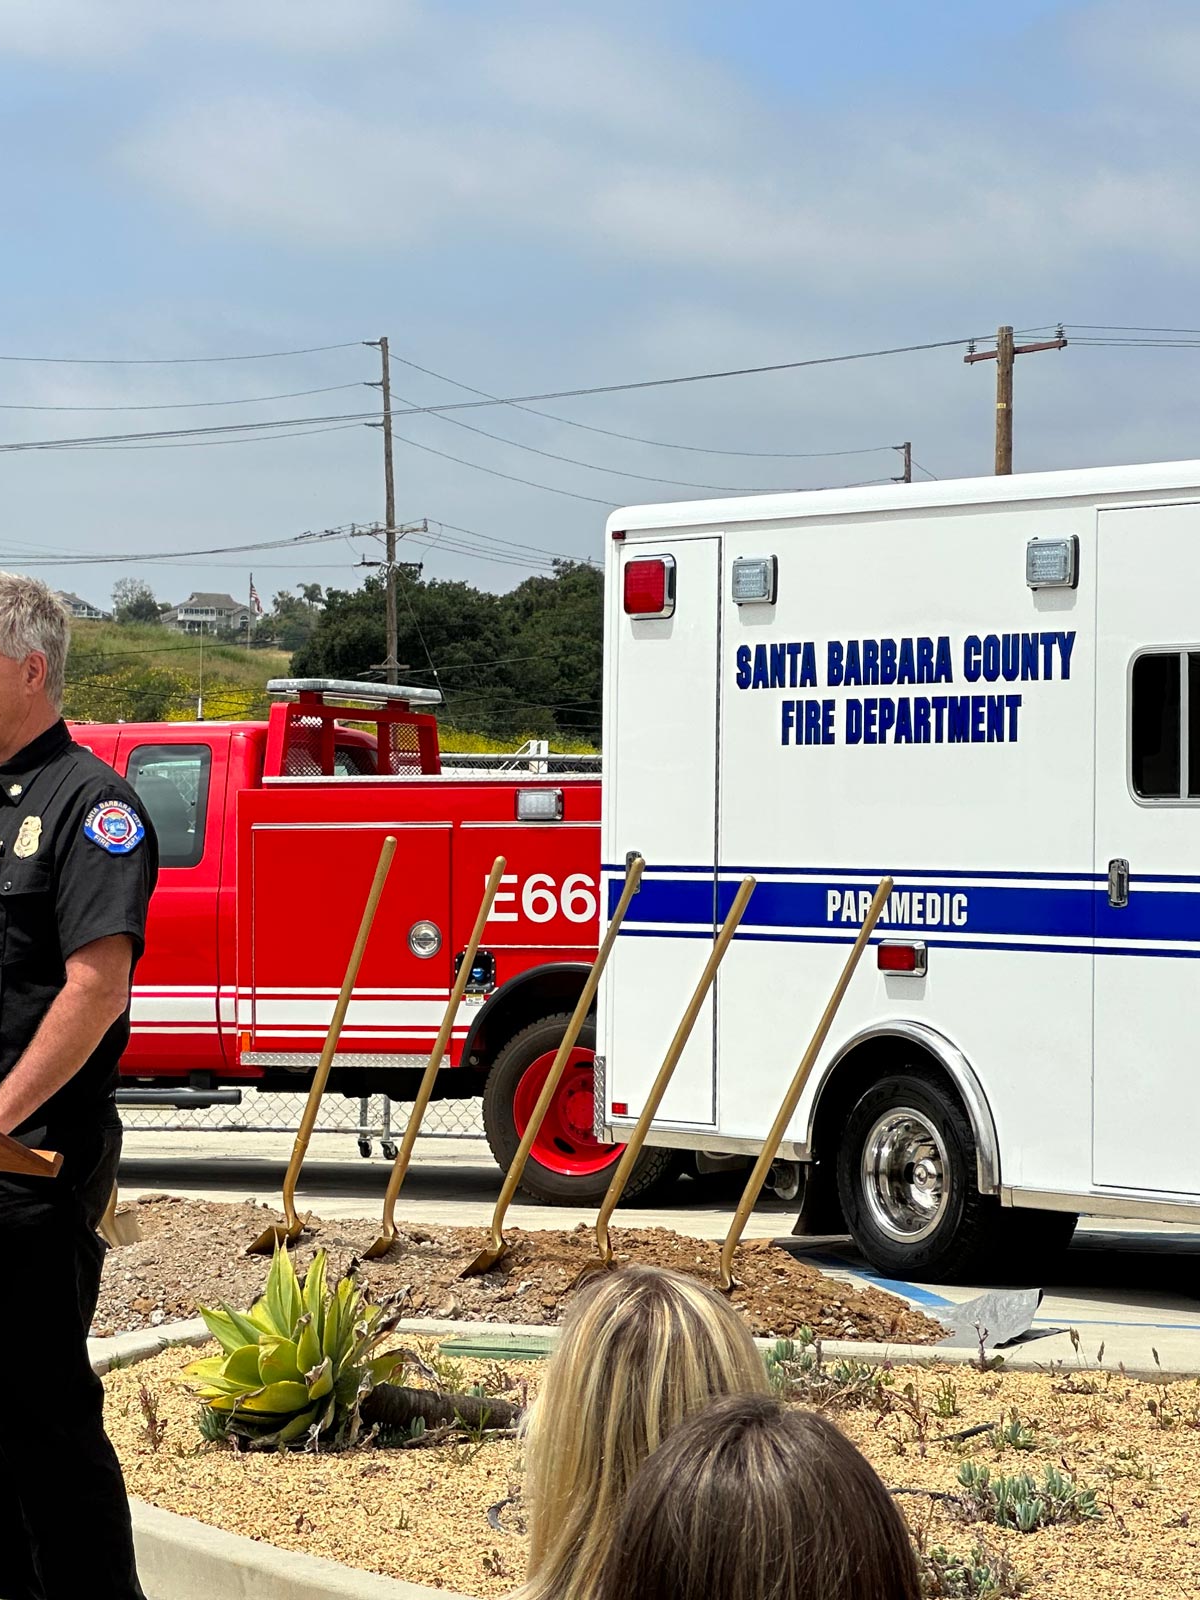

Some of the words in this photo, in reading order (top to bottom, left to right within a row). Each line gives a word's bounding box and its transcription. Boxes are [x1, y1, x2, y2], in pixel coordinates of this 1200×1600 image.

[736, 642, 817, 690] SANTA
[827, 636, 953, 687] BARBARA
[963, 631, 1076, 682] COUNTY
[781, 699, 836, 746] FIRE
[845, 694, 1022, 745] DEPARTMENT
[85, 807, 99, 827] SANTA
[94, 835, 111, 848] FIRE
[484, 873, 600, 924] E66
